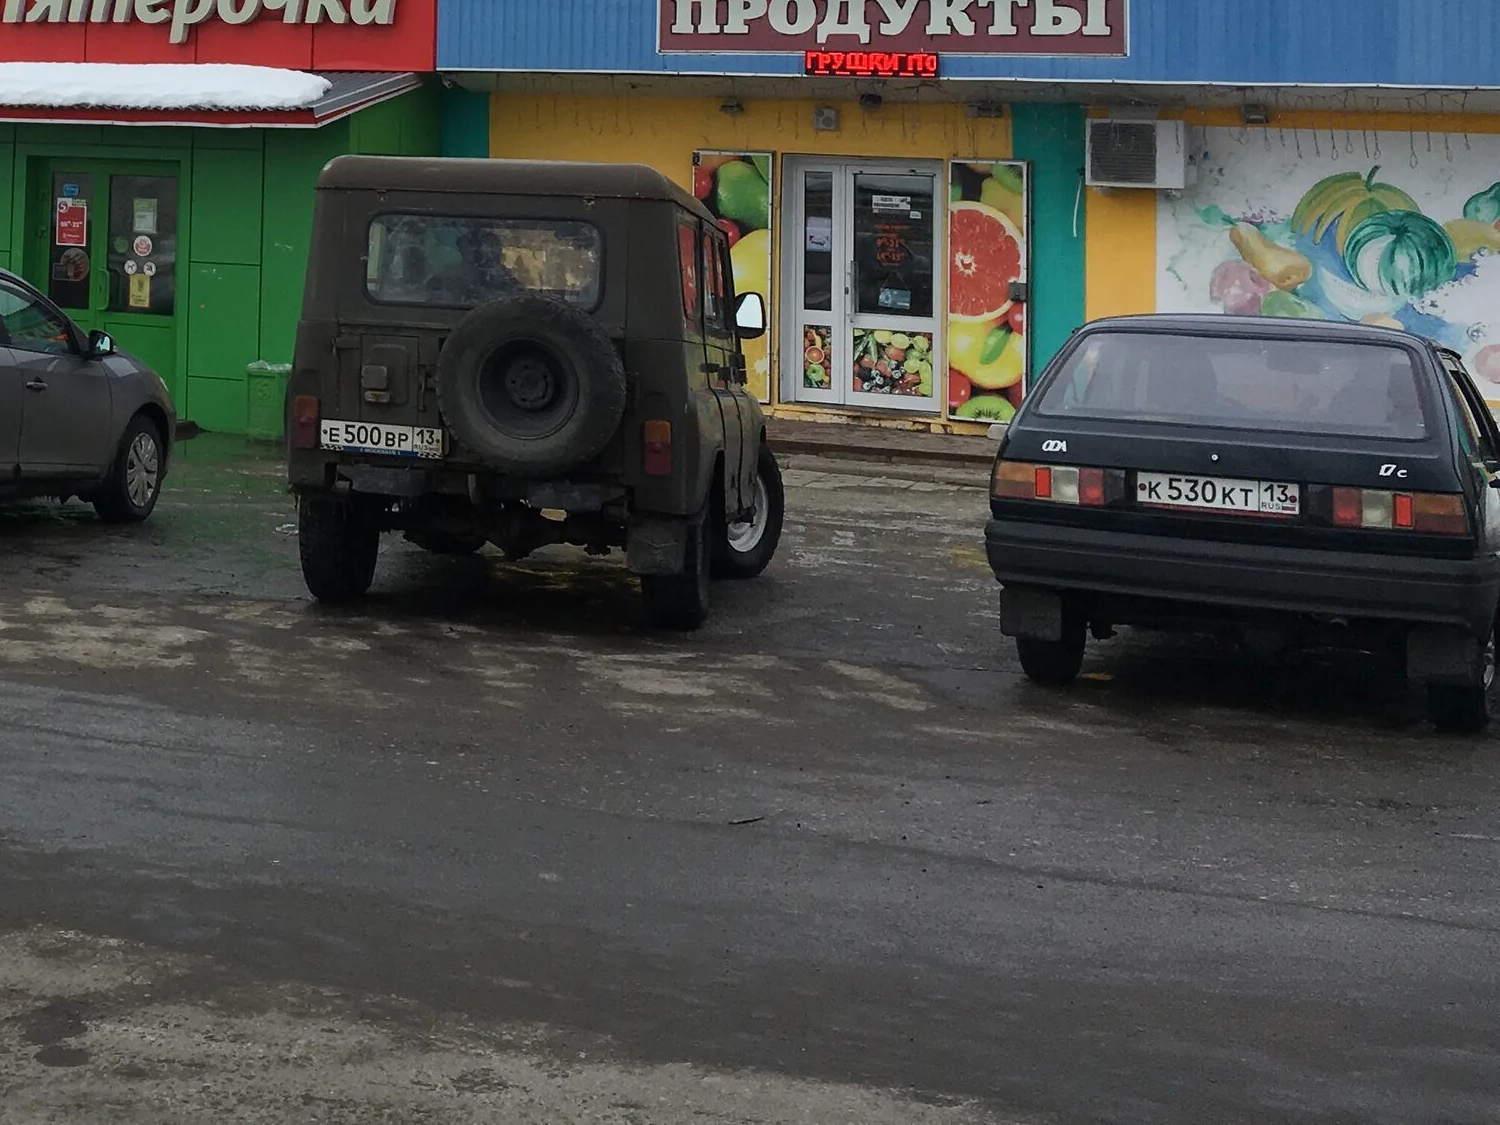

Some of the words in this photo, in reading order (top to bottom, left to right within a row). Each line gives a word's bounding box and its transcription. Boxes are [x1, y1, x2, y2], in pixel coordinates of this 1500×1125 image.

[329, 424, 409, 447] Е500ВР
[416, 429, 434, 444] 13
[1148, 477, 1253, 507] К530КТ
[1263, 483, 1288, 503] 13
[1261, 501, 1280, 510] RUS
